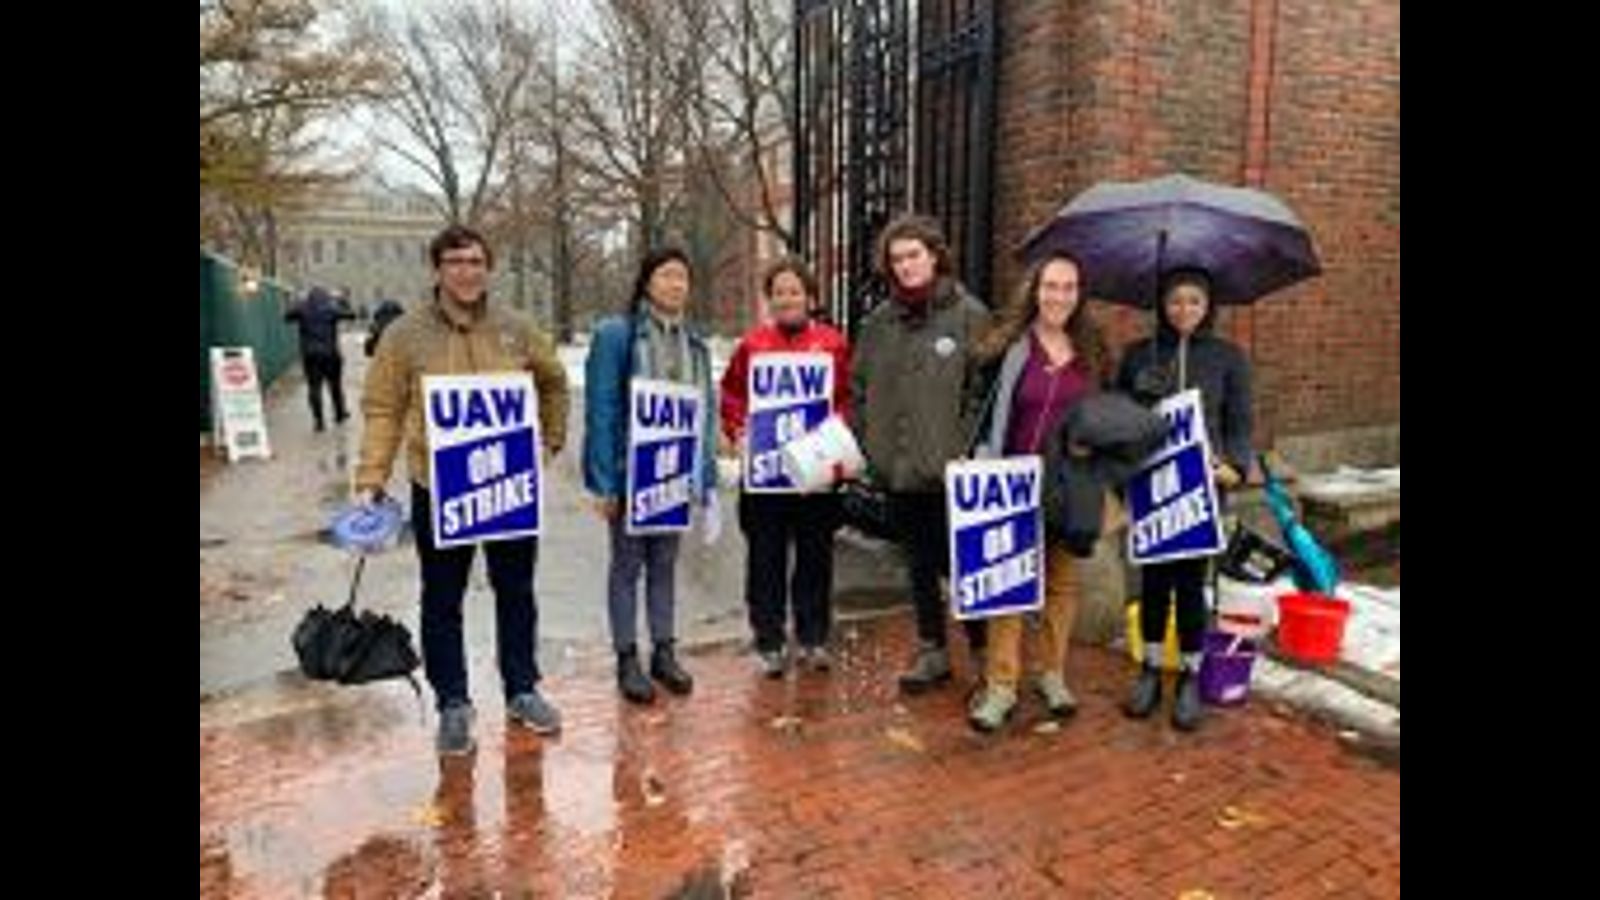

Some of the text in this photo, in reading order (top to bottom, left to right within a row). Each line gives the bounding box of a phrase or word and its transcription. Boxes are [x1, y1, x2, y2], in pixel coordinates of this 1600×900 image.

[754, 366, 827, 396] UAW
[431, 389, 525, 429] UAW
[637, 395, 697, 431] UAW
[467, 442, 505, 483] ON
[443, 474, 535, 534] STRIKE
[955, 470, 1036, 510] UAW
[960, 547, 1036, 606] STRIKE
